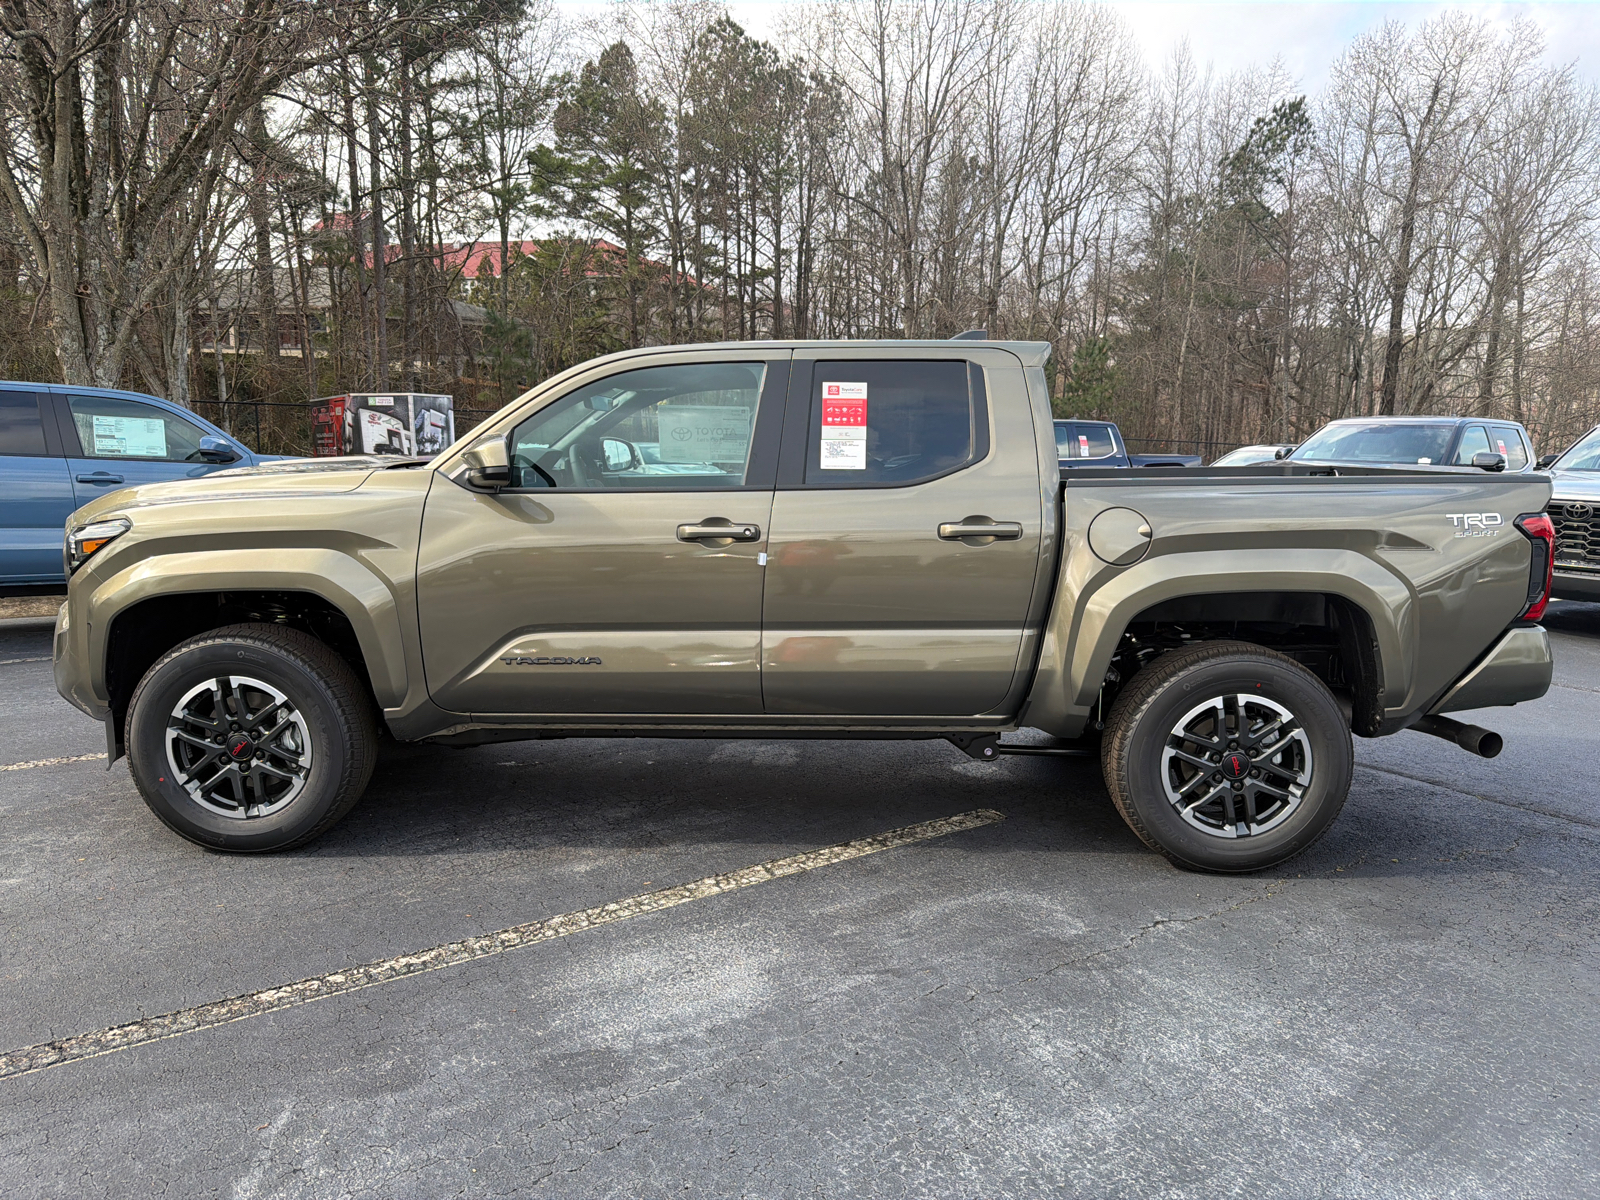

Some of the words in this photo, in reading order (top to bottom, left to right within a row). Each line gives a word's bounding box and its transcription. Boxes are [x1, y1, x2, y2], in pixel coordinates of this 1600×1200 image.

[695, 427, 738, 436] TOYOTA
[1445, 512, 1504, 530] TRD
[1453, 530, 1499, 538] SPORT
[500, 656, 602, 665] TACOMA
[232, 740, 248, 756] TRD
[1231, 756, 1241, 776] TRD
